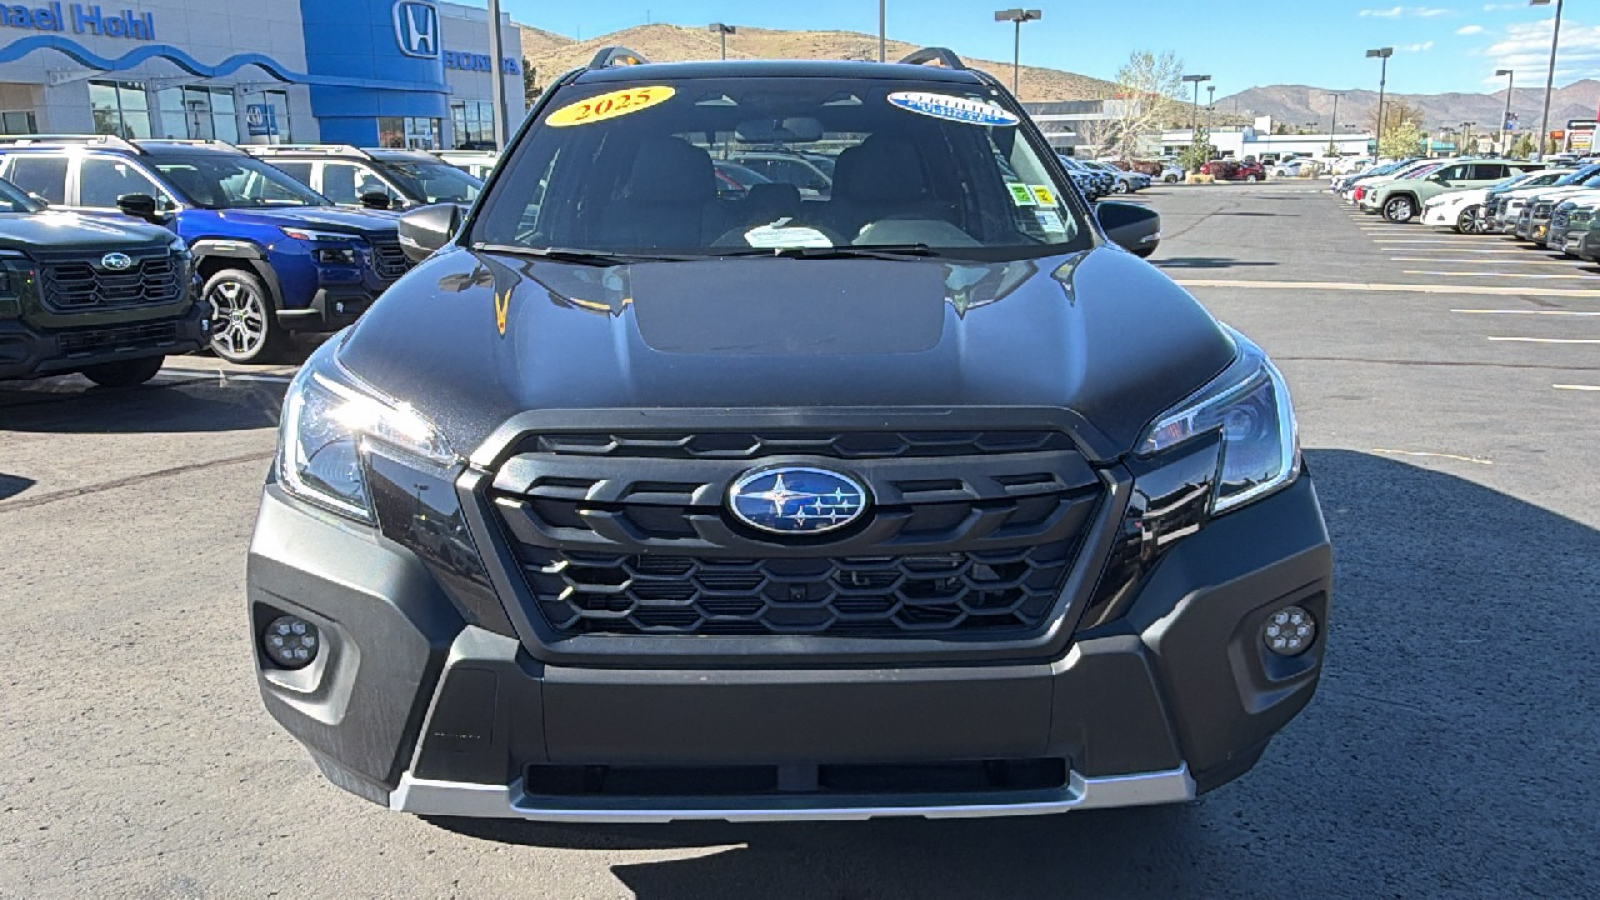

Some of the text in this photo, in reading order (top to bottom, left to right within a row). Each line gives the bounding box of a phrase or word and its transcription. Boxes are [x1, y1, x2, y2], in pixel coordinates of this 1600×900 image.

[70, 3, 156, 40] Hohl
[442, 49, 520, 75] HONA
[574, 88, 651, 121] 2025
